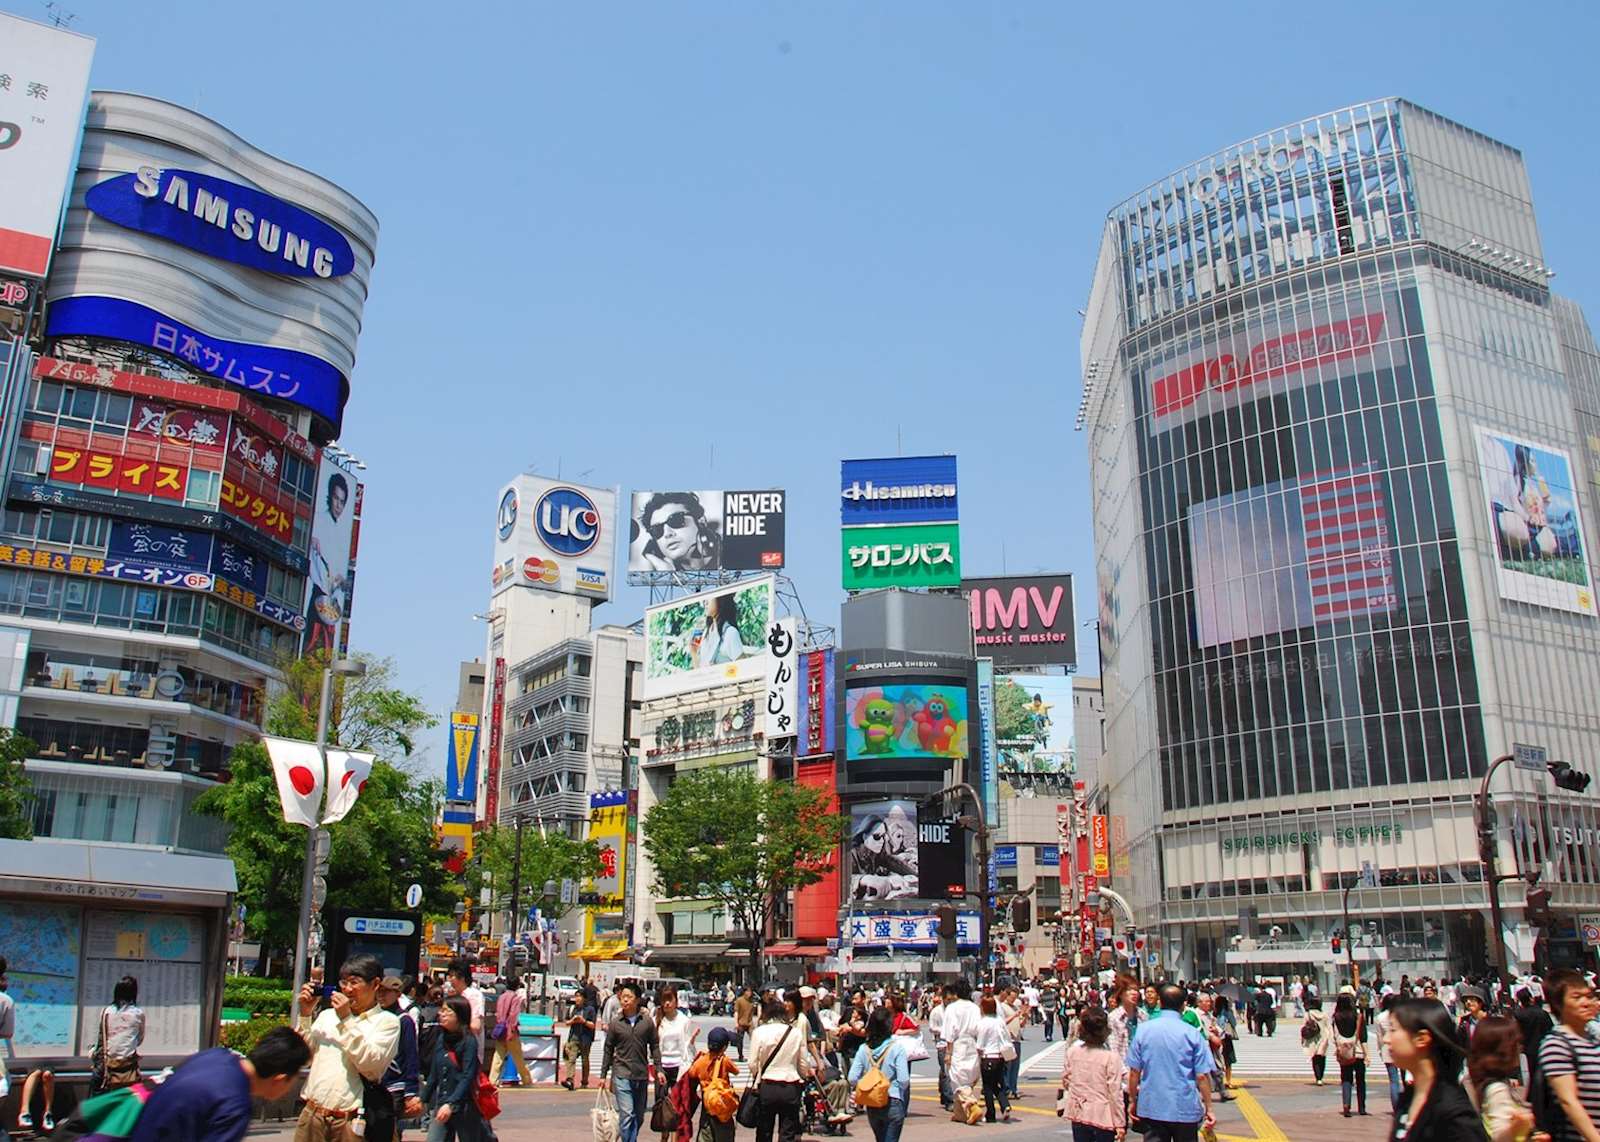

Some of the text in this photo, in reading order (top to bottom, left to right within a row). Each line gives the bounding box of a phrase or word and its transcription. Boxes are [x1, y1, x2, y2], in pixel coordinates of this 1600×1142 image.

[133, 165, 335, 279] SAMSUNG
[151, 321, 300, 398] 日本サムスン
[53, 449, 183, 491] プライス
[842, 481, 956, 501] Hisamitsu
[221, 478, 292, 534] コンタクト
[726, 493, 782, 513] NEVER
[202, 514, 214, 524] 7F
[726, 514, 767, 535] HIDE
[848, 542, 954, 568] サロンパス
[187, 575, 208, 586] 6F
[581, 573, 601, 584] VISA
[975, 630, 1067, 644] music master
[855, 662, 882, 671] SUPER
[904, 660, 938, 668] SHIBUYA
[768, 622, 793, 732] もんじゃ
[918, 824, 951, 844] HIDE
[1223, 822, 1403, 850] STARBUCKS COFFEE
